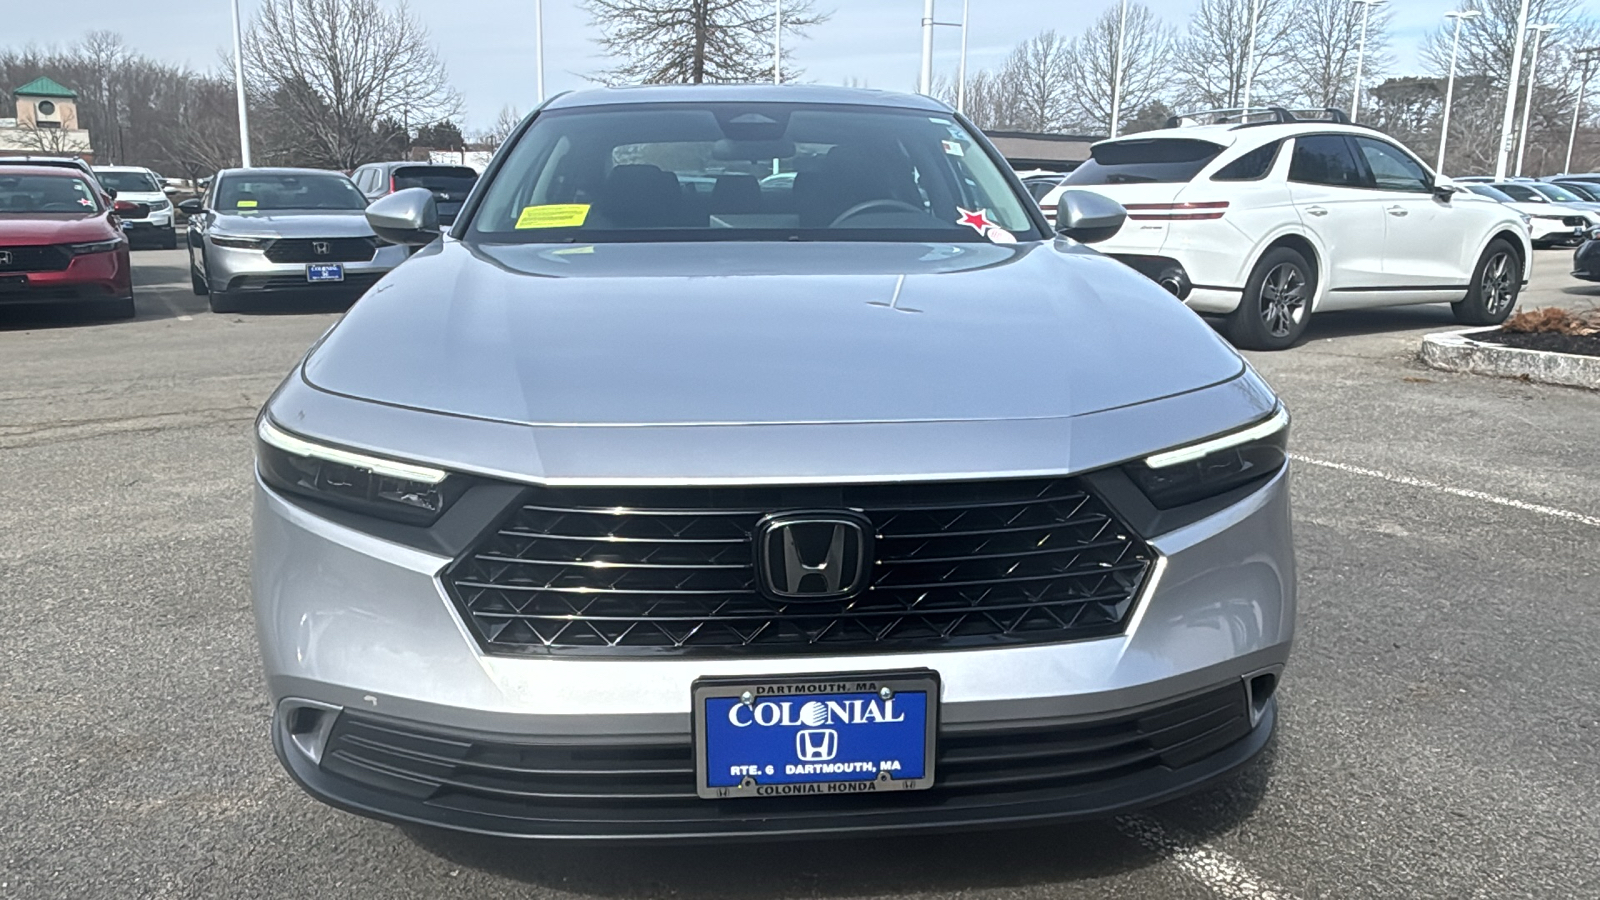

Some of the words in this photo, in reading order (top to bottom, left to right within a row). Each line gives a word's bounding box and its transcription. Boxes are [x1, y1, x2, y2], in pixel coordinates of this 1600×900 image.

[856, 682, 877, 691] MA
[728, 700, 905, 727] COLONIAL
[730, 765, 762, 776] RTE.
[765, 765, 775, 776] 6
[785, 762, 877, 775] DARTMOUTH,
[880, 760, 901, 771] MA
[756, 784, 824, 796] COLONIAL
[827, 782, 876, 793] HONDA
